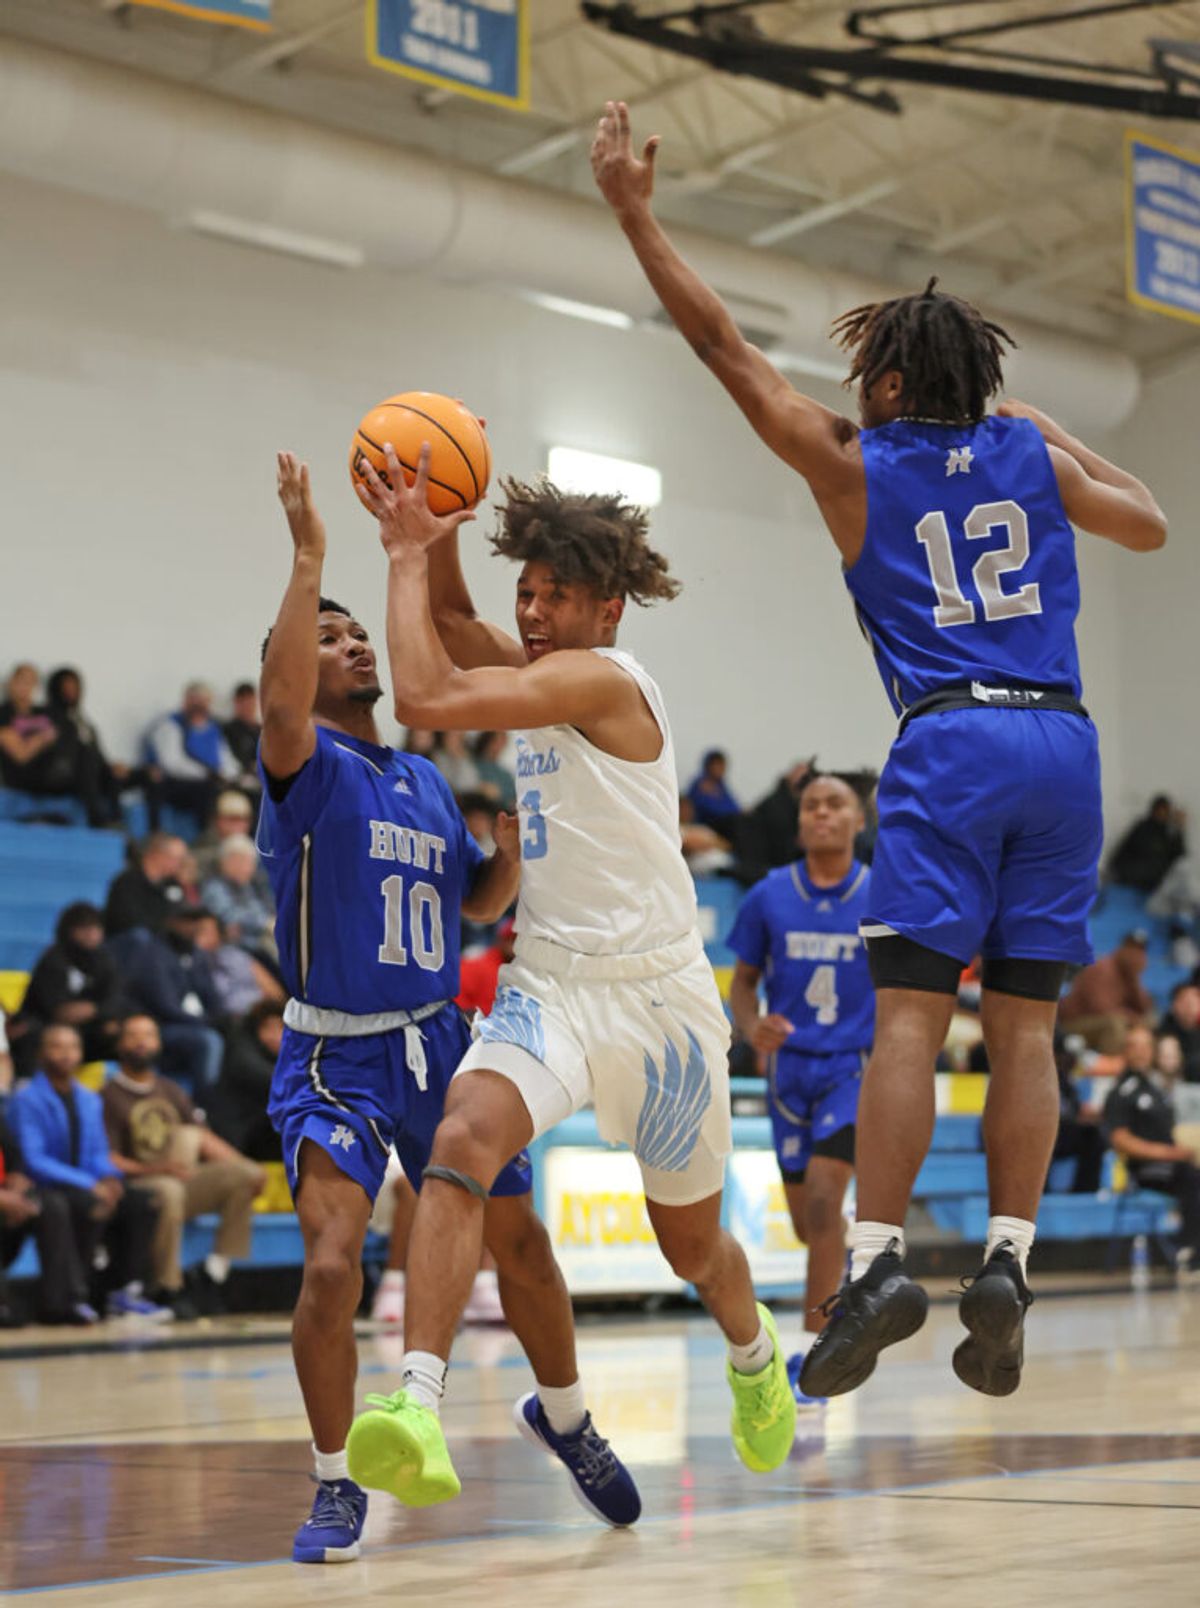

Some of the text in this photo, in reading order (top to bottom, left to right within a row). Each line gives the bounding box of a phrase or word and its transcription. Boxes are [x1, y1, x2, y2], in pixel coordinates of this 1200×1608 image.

[914, 500, 1043, 628] 12
[368, 818, 447, 875] HUNT
[378, 874, 445, 972] 10
[805, 965, 838, 1025] 4
[557, 1190, 658, 1246] AYCOC
